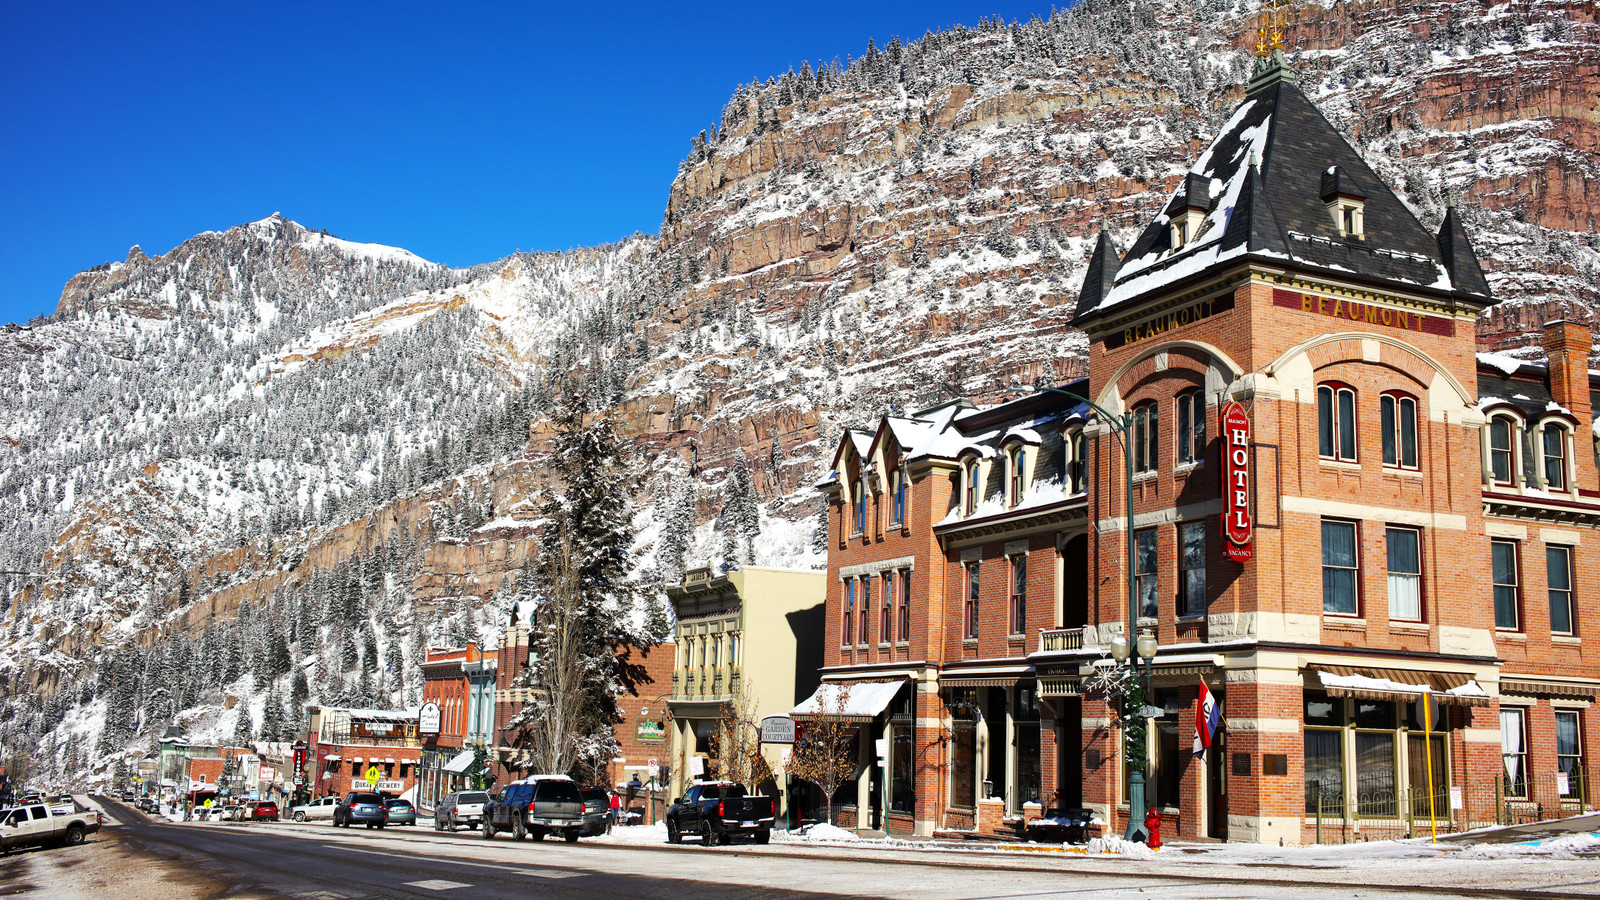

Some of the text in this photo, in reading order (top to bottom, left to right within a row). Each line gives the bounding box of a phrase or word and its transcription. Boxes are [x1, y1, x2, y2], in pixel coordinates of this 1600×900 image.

[1124, 298, 1215, 346] BEAUMONT
[1301, 293, 1426, 332] BEAUMONT
[1231, 428, 1248, 529] HOTEL
[1228, 549, 1252, 557] VACANCY
[762, 733, 794, 741] COURTYARD
